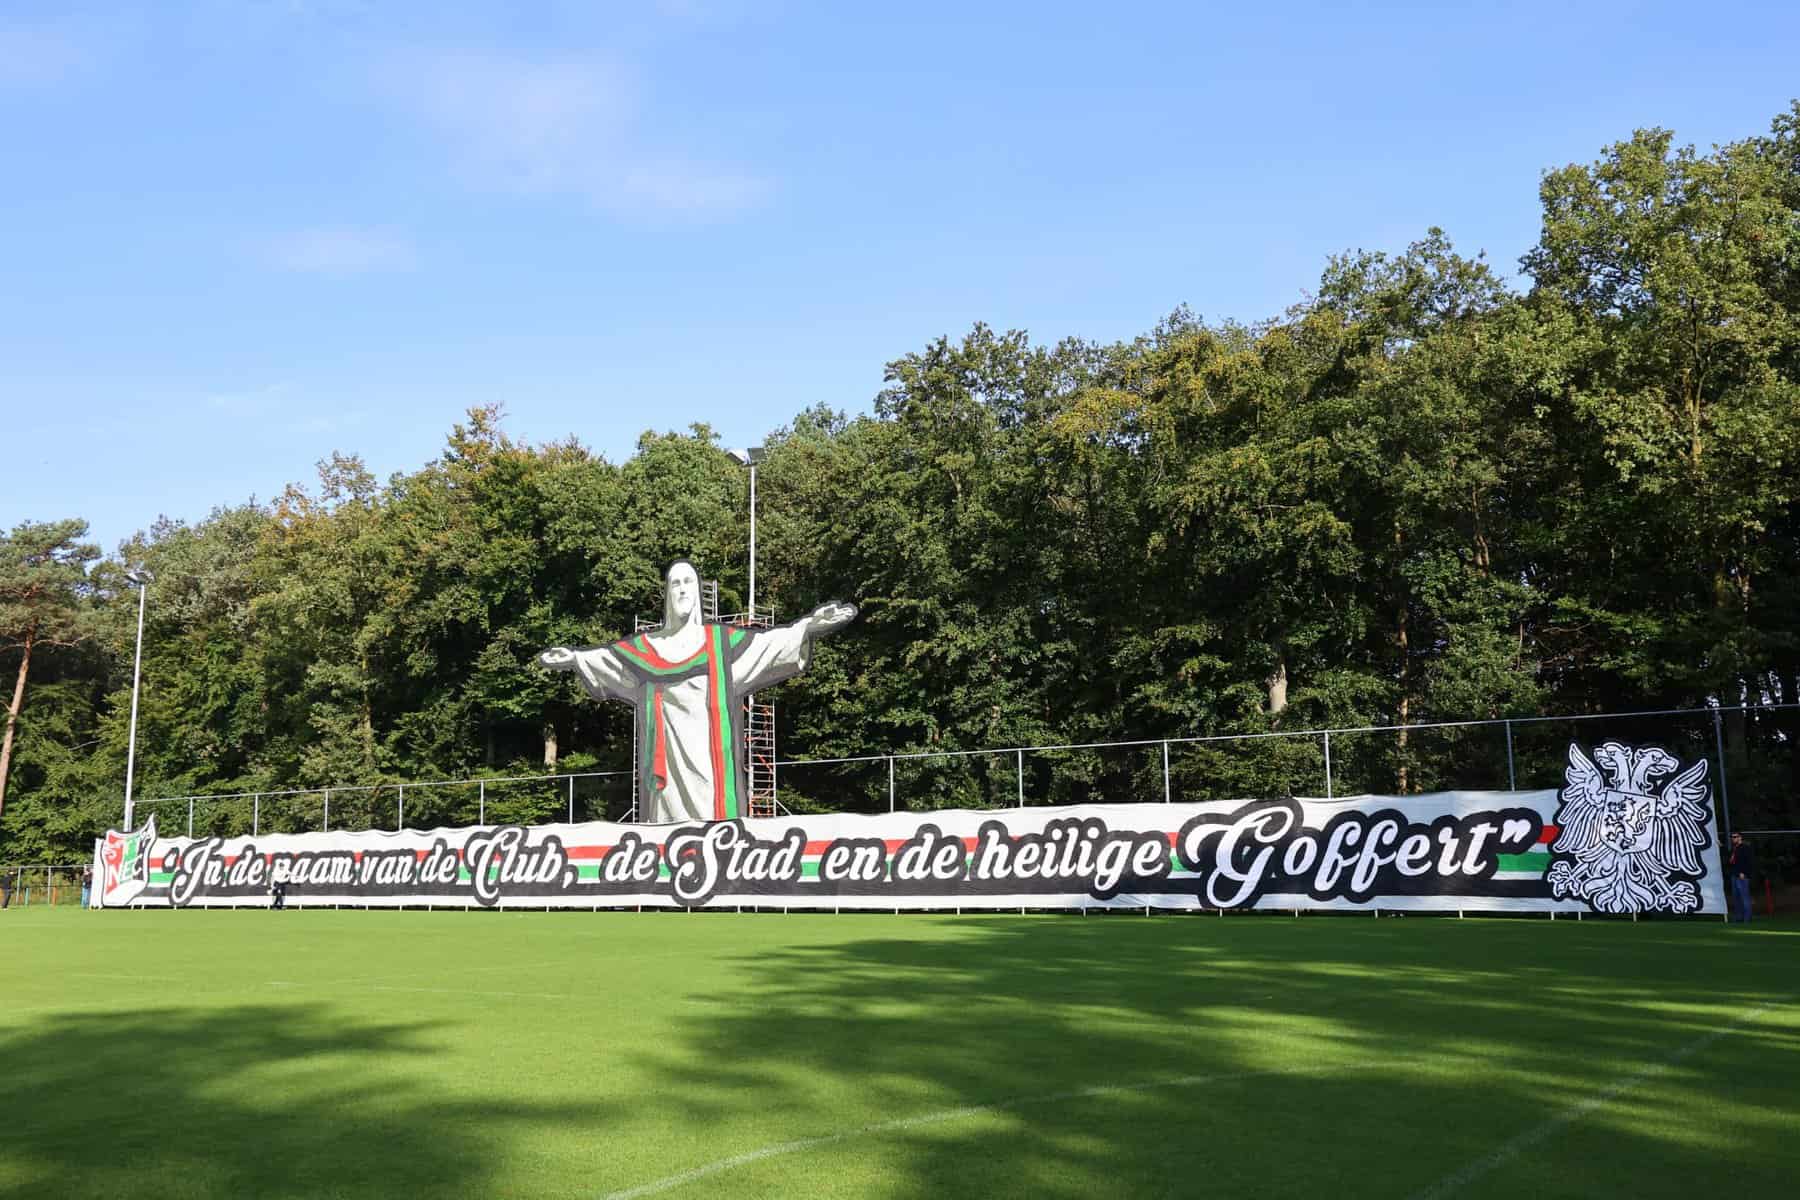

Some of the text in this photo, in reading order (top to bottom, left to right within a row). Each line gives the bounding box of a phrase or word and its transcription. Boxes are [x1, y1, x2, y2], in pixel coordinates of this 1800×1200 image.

[107, 853, 143, 887] NEC
[229, 849, 264, 885] de
[361, 855, 413, 884] van
[421, 844, 456, 882] de
[467, 825, 573, 898] Club,
[606, 840, 655, 882] de
[668, 821, 798, 898] Stad
[826, 844, 880, 880] en
[899, 834, 959, 880] de
[978, 826, 1164, 891] heilige
